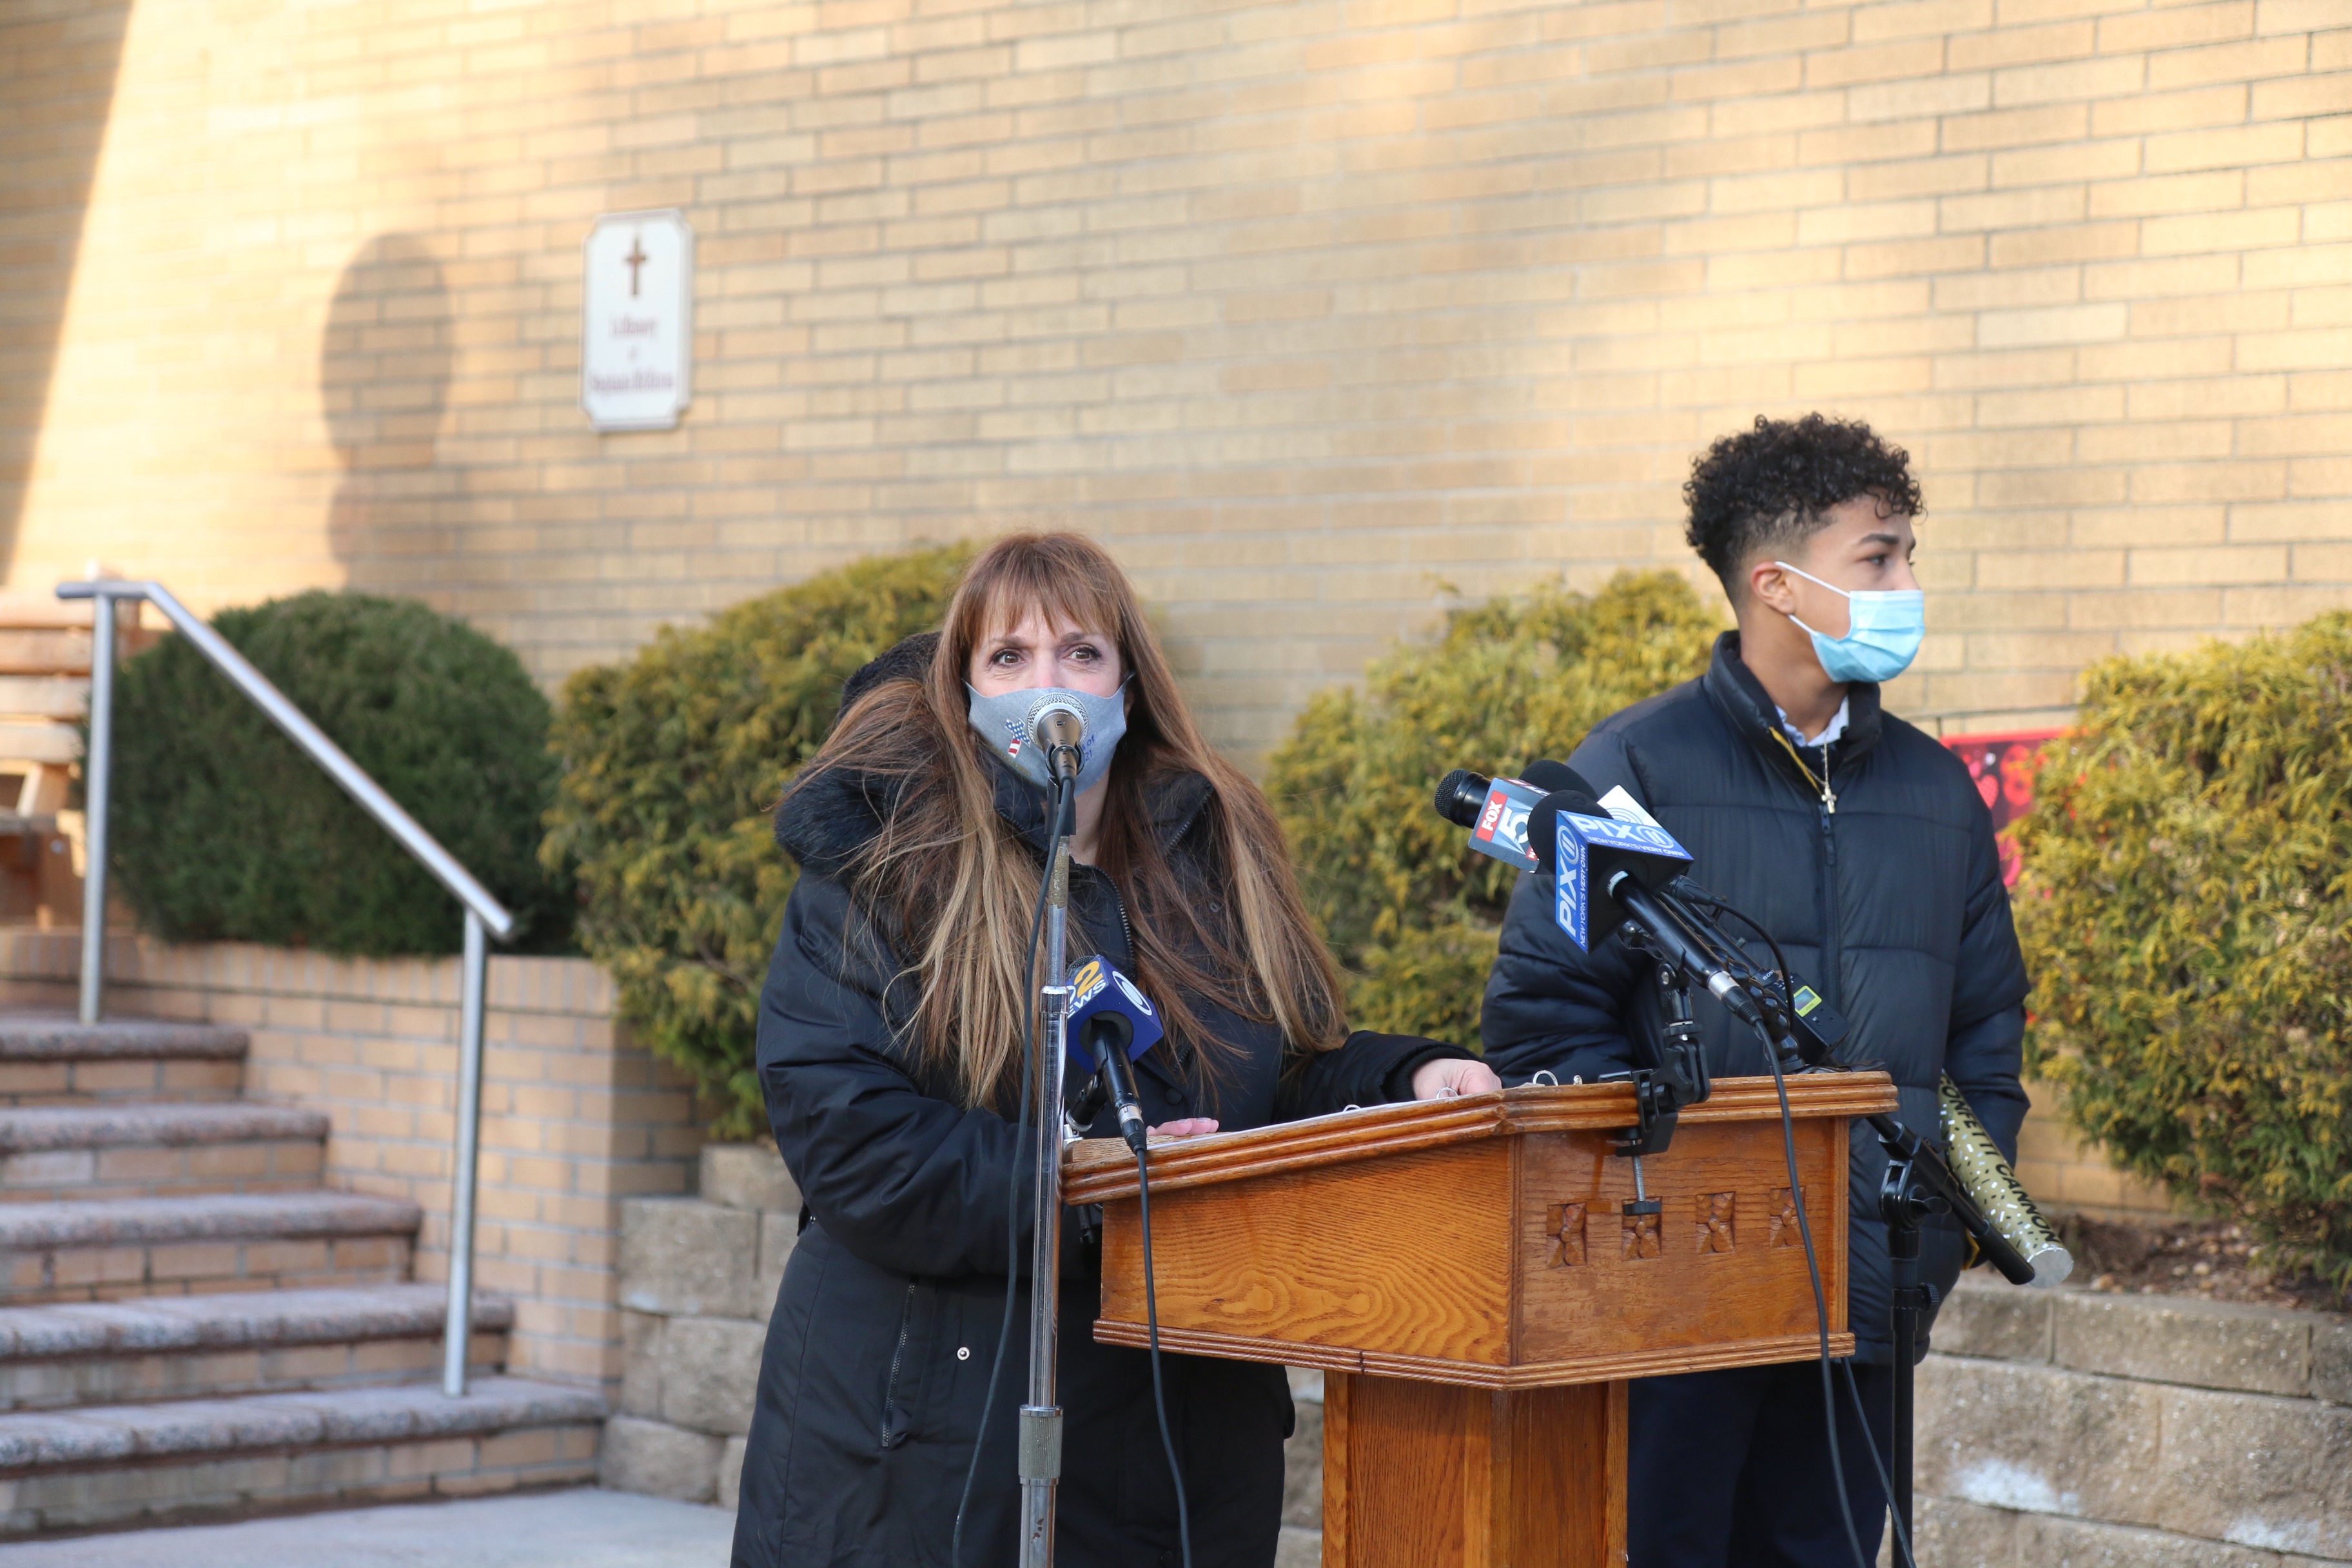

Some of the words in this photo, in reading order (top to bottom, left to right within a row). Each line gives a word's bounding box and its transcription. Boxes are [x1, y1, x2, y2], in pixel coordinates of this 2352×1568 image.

[1087, 734, 1094, 746] of
[1482, 800, 1503, 832] FOX
[1498, 807, 1530, 844] 5
[1609, 839, 1640, 850] YORK'S
[1663, 848, 1685, 857] OWN
[1074, 961, 1103, 999] 2
[1067, 979, 1106, 1019] EWS
[1995, 1164, 2061, 1243] CANNON
